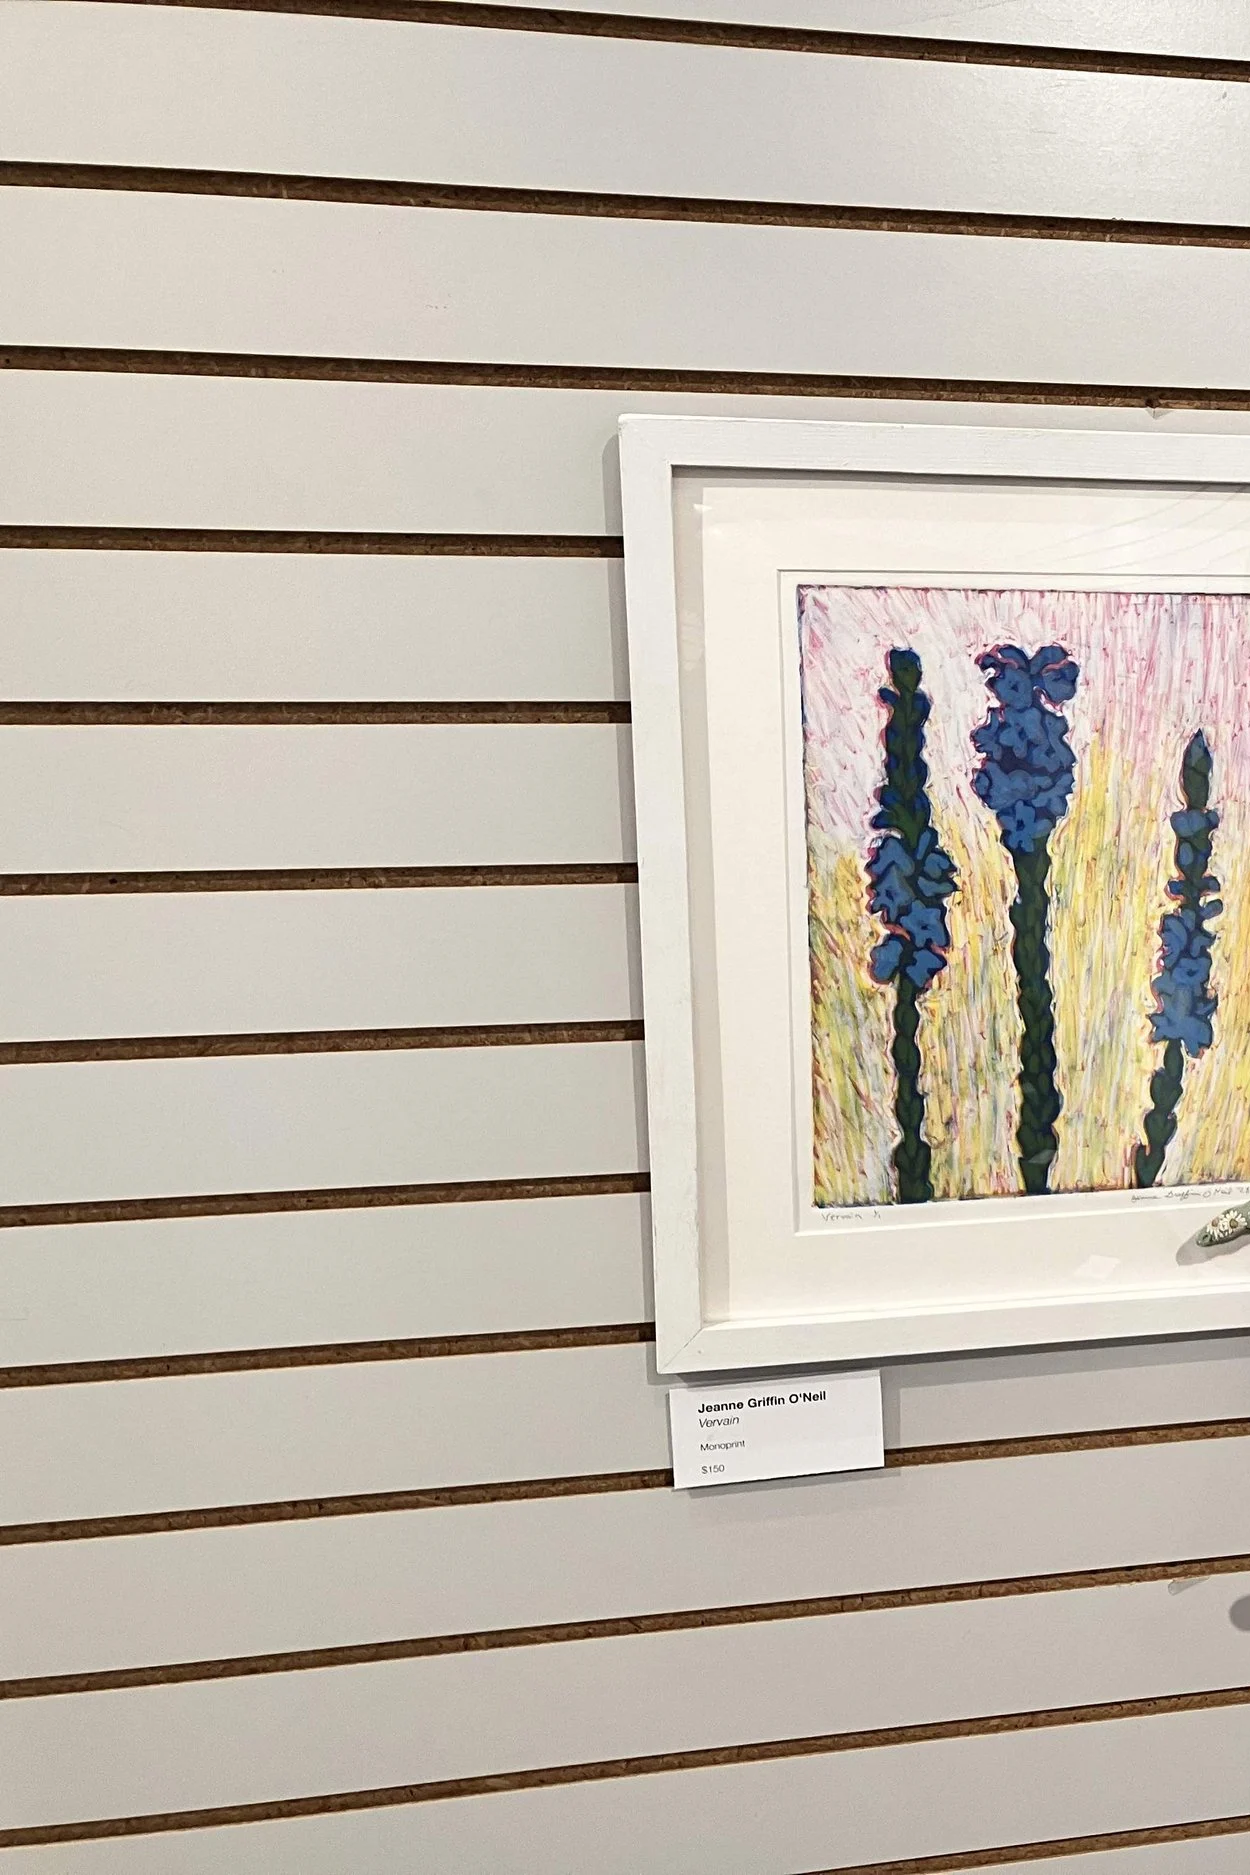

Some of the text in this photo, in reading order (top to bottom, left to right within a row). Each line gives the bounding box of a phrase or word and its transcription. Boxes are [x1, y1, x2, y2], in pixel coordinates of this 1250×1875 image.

[697, 1391, 826, 1413] Jeanne Griffin O'Neil
[698, 1416, 740, 1428] Vervain
[700, 1440, 746, 1451] Monoprint
[701, 1465, 725, 1475] $150
